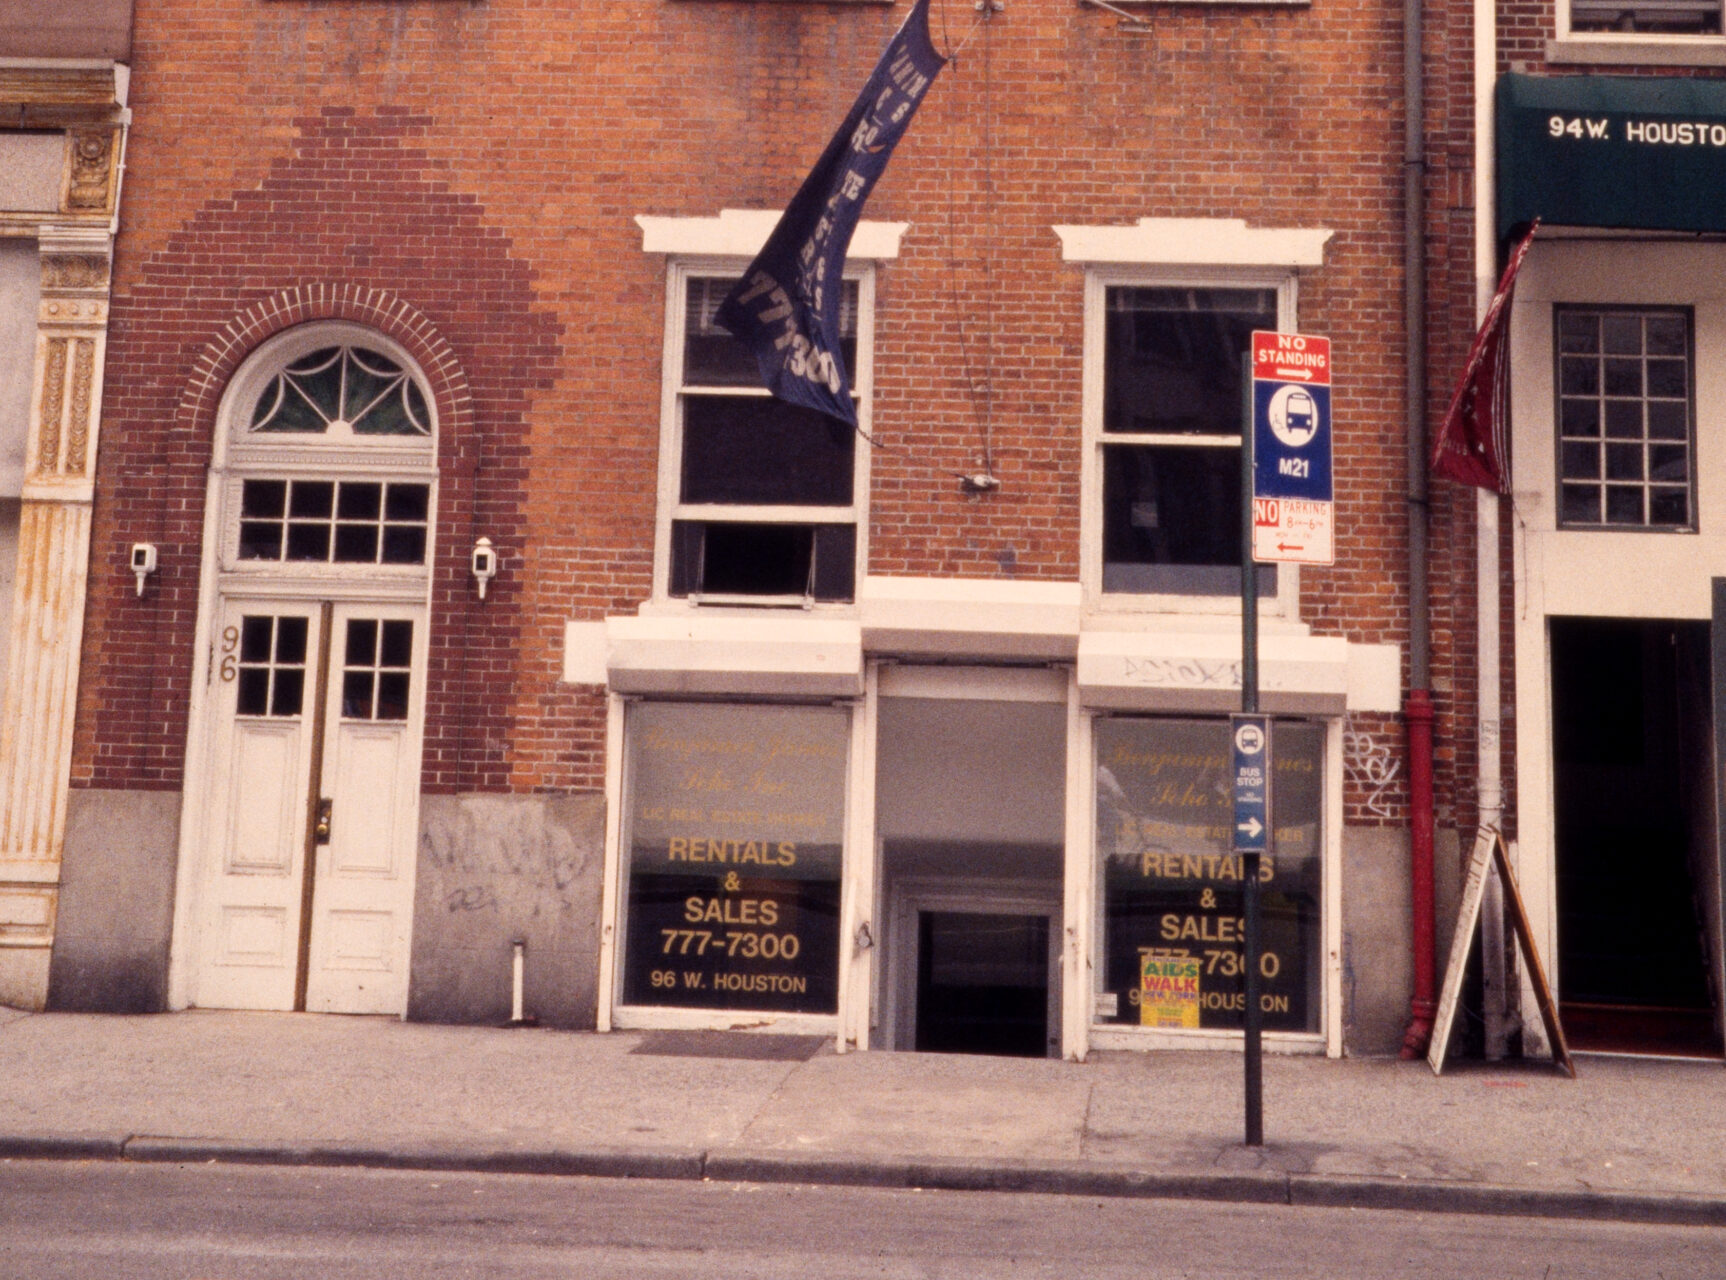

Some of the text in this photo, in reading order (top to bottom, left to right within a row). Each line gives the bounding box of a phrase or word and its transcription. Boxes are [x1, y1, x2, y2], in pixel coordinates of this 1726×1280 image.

[1278, 335, 1306, 351] NO
[1259, 349, 1326, 368] STANDING
[1279, 457, 1309, 478] M21
[1255, 500, 1278, 523] NO
[1283, 500, 1327, 516] PARKING
[221, 625, 239, 682] 96
[1236, 777, 1264, 787] STOP
[1240, 767, 1260, 777] BUS
[668, 837, 797, 866] RENTALS
[724, 871, 741, 892] &
[1200, 888, 1217, 908] &
[684, 896, 779, 925] SALES
[661, 930, 799, 959] 777-7300
[1144, 962, 1198, 978] AIDS
[651, 970, 806, 993] 96 W. HOUSTON
[1143, 976, 1198, 992] WALK
[1199, 991, 1289, 1013] HOUSON
